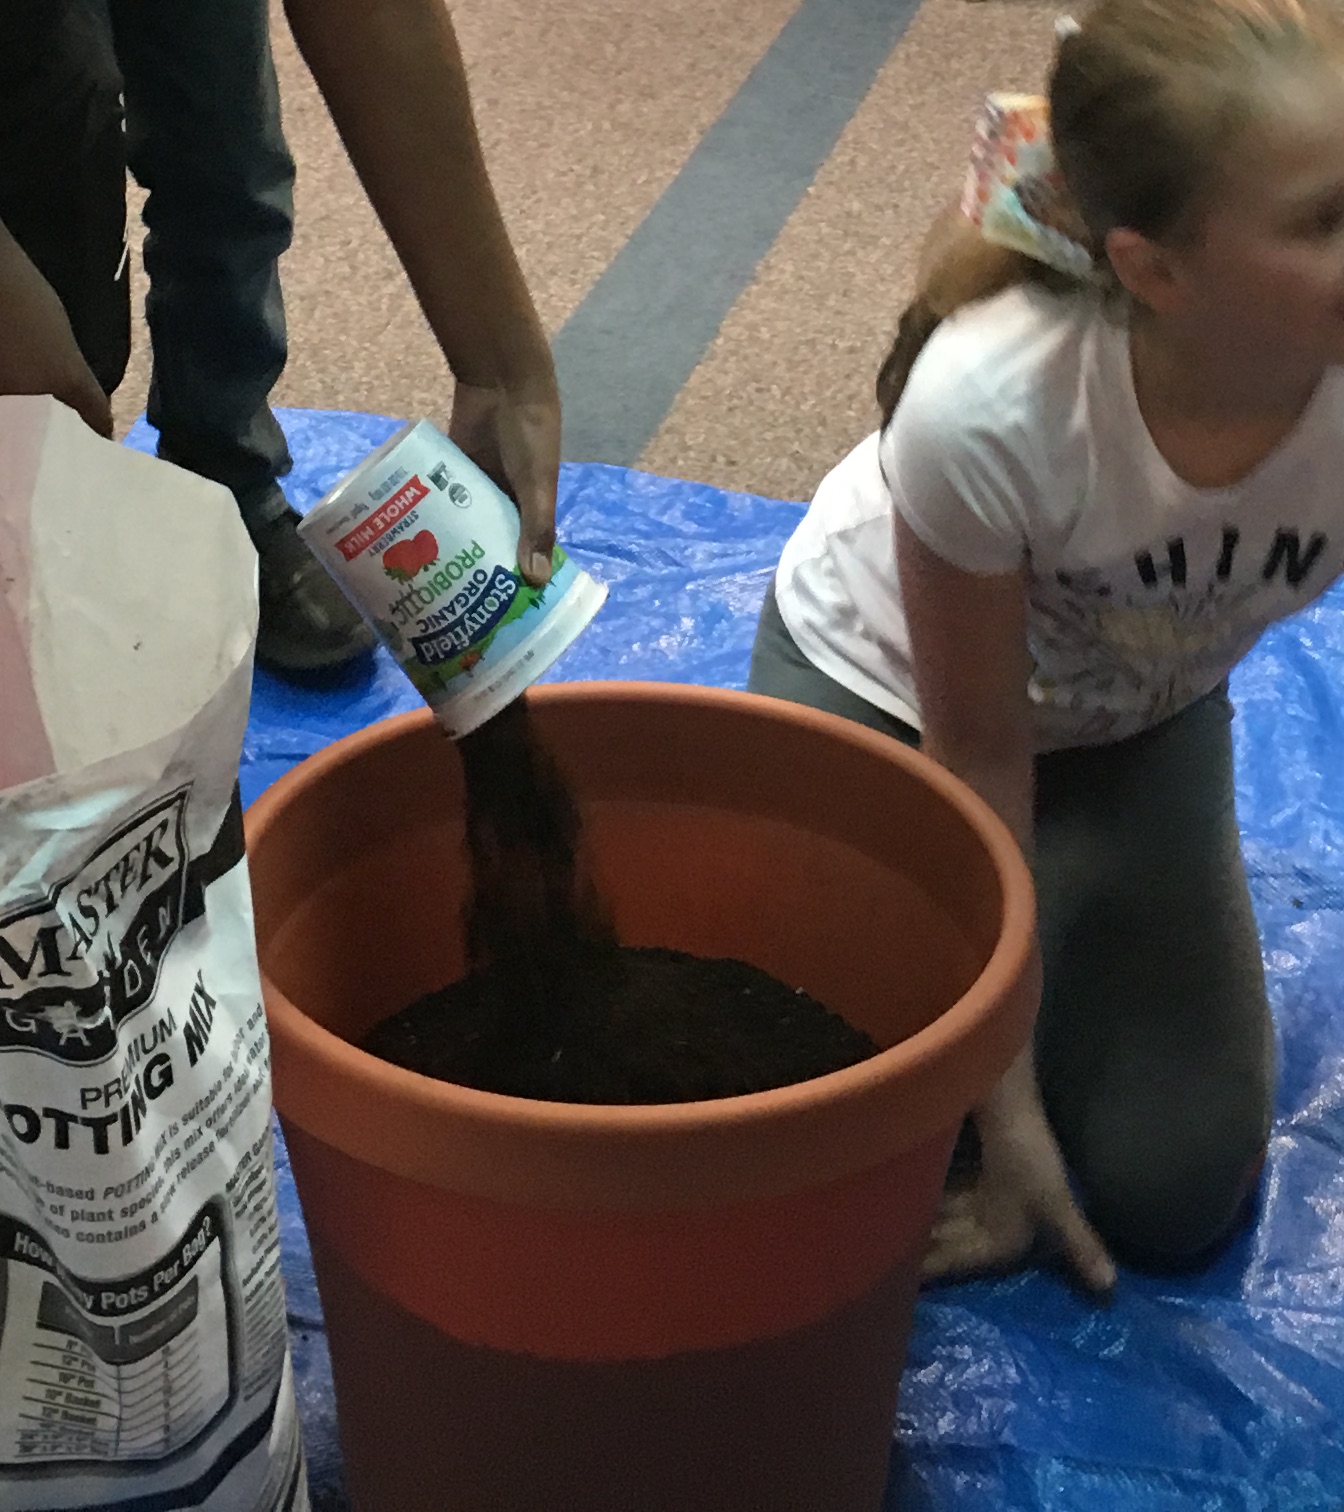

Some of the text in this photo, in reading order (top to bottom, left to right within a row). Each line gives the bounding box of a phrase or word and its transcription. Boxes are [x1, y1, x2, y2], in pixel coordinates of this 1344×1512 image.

[345, 522, 377, 555] MILK
[373, 486, 422, 530] WHOLE
[1132, 524, 1330, 587] HIN
[416, 569, 488, 634] ORGANIC
[421, 572, 518, 664] Stonyfield
[5, 895, 172, 1048] GADEN
[182, 969, 218, 1068] MIX
[80, 1007, 178, 1110] PREMIUM
[70, 1202, 115, 1223] plant
[76, 1217, 146, 1245] contains
[101, 1284, 149, 1311] Pots
[152, 1259, 180, 1293] Per
